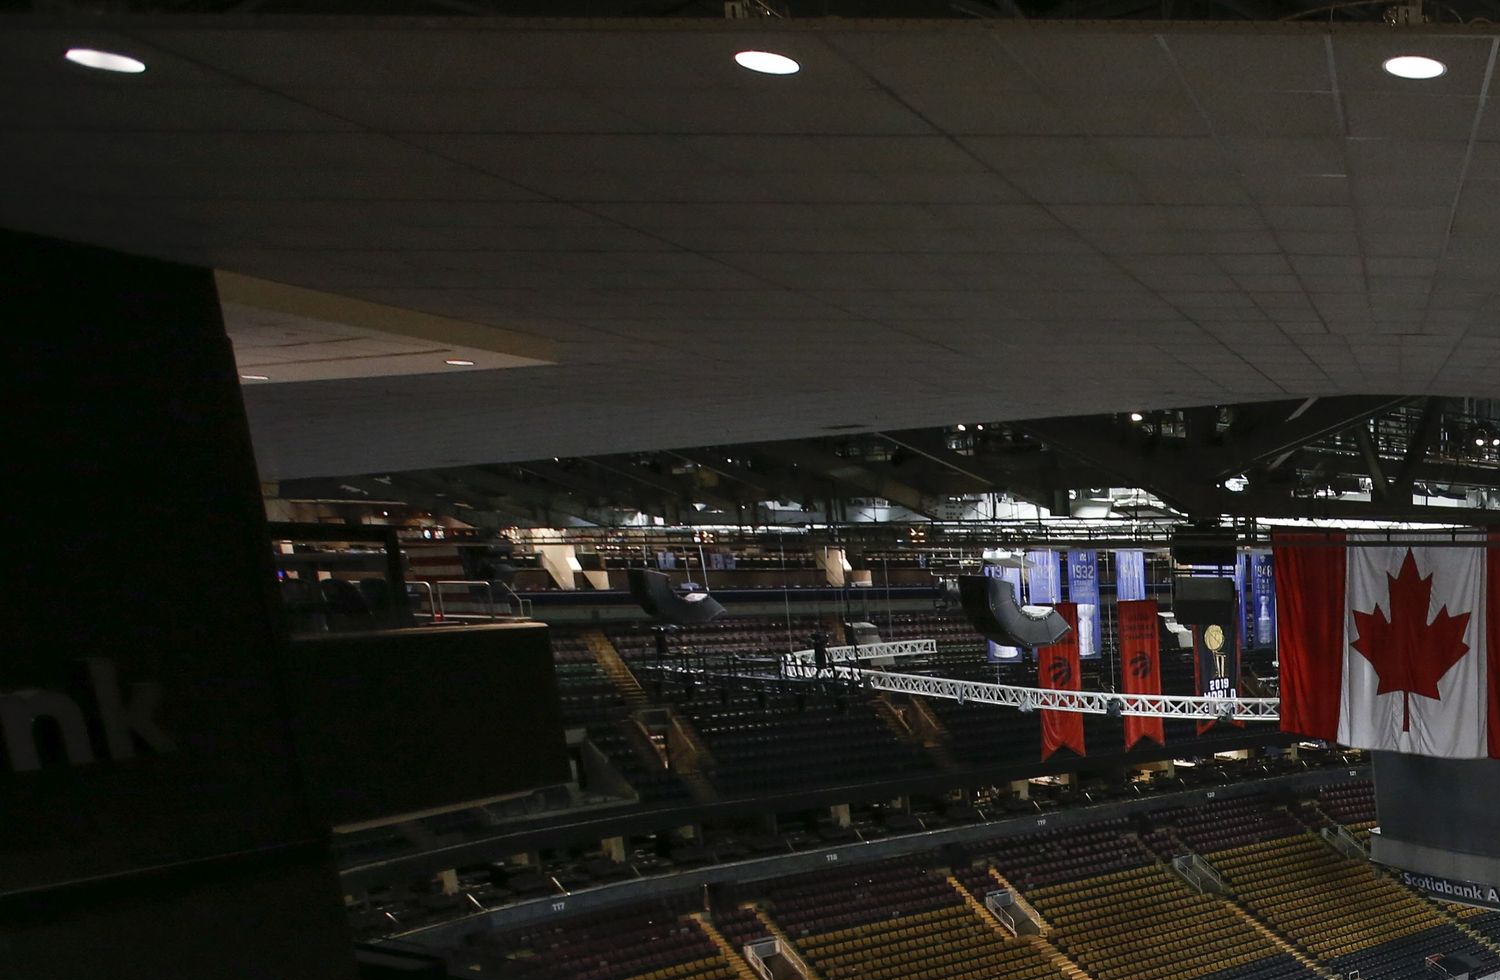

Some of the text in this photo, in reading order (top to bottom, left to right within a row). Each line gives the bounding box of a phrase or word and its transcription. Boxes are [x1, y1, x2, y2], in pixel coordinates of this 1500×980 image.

[1072, 564, 1094, 579] 1932
[1209, 678, 1230, 690] 2019
[1403, 872, 1483, 902] Scotiabank
[552, 901, 566, 912] 117
